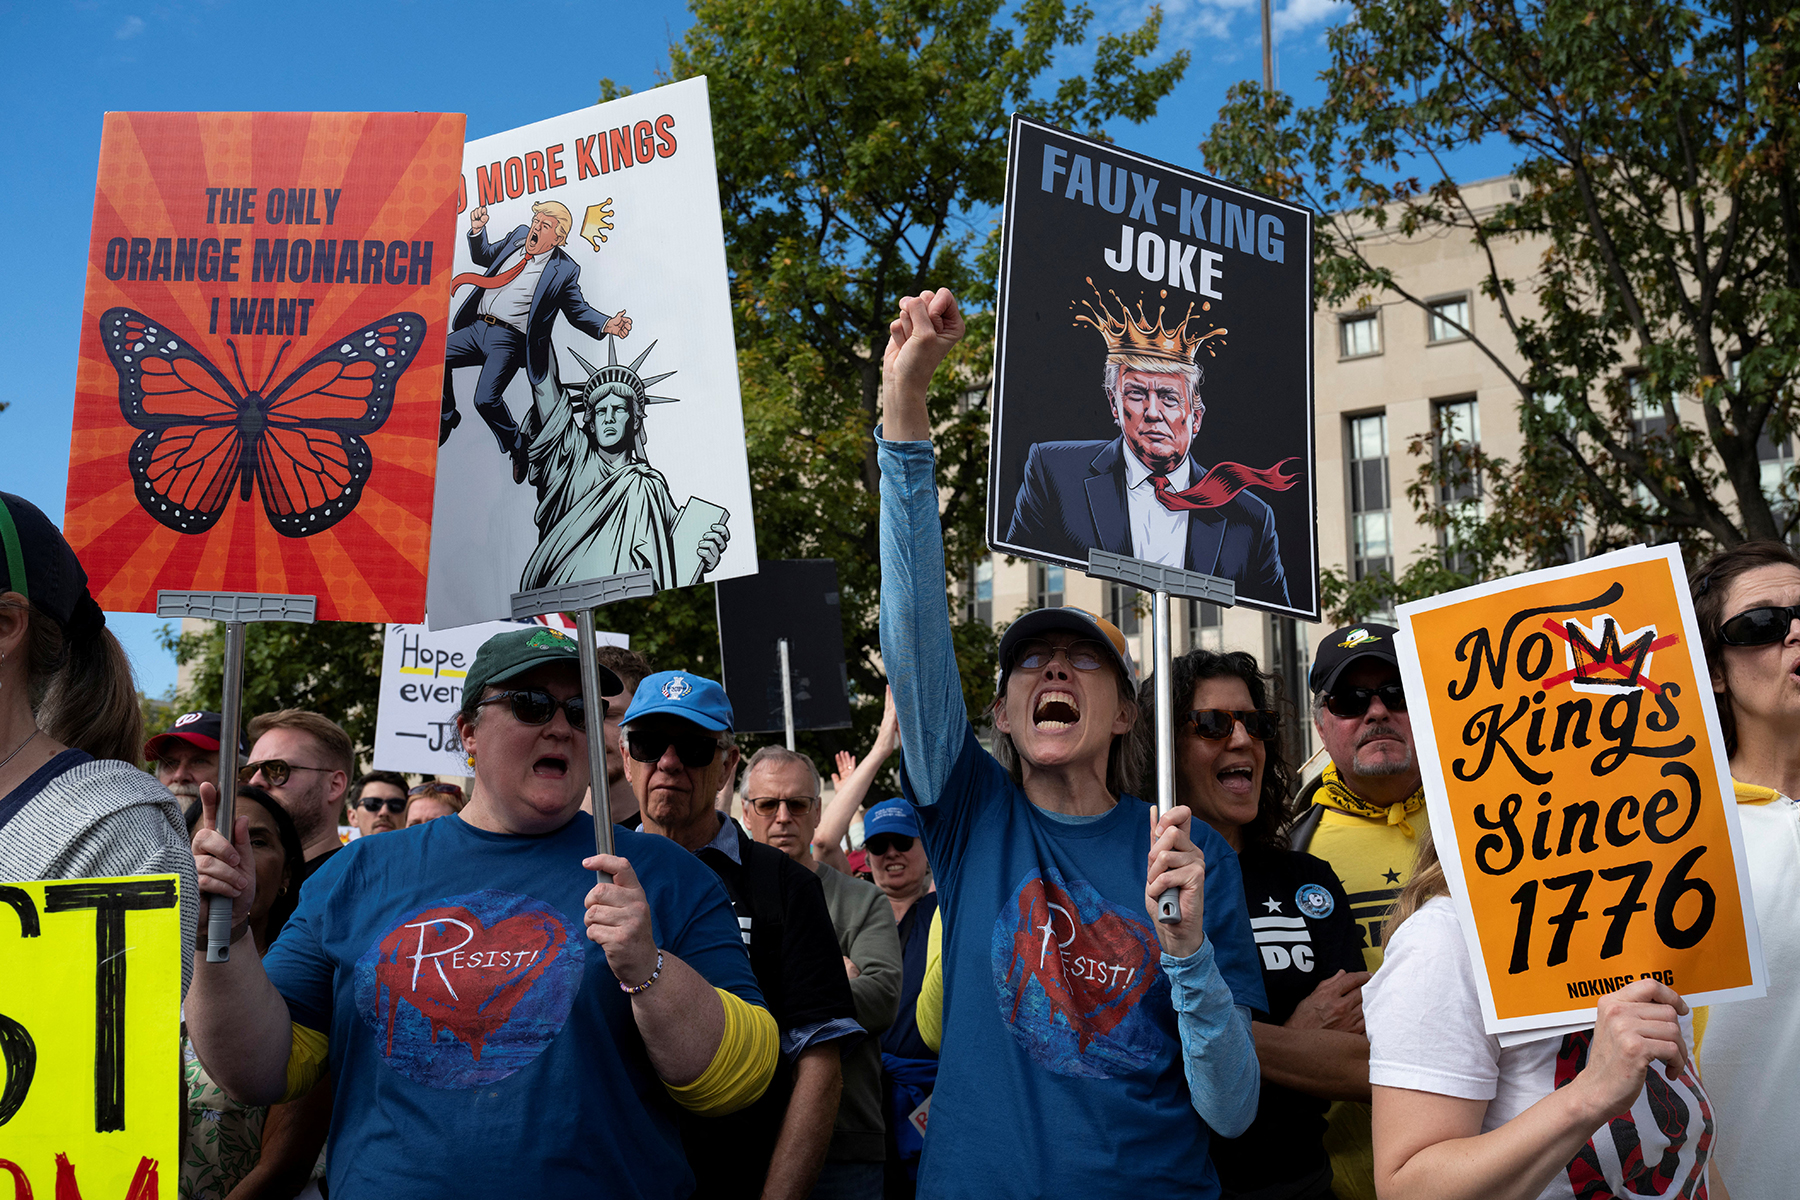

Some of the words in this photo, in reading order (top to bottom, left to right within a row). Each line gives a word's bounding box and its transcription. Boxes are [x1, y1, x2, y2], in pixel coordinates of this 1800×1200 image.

[476, 143, 567, 207] MORE
[575, 113, 678, 181] KINGS
[206, 187, 258, 225] THE
[265, 187, 342, 226] ONLY
[1040, 143, 1286, 265] FAUX-KING
[104, 236, 242, 283] ORANGE
[251, 238, 434, 286] MONARCH
[1104, 224, 1224, 301] JOKE
[208, 297, 220, 335] I
[229, 297, 315, 337] WANT
[1447, 581, 1624, 702] No
[400, 683, 464, 703] ever
[1452, 680, 1696, 786] Kings
[1473, 761, 1700, 876] Since
[1036, 901, 1135, 996] RESIST!
[1508, 845, 1717, 976] 1776
[403, 918, 539, 1001] RESIST!
[1259, 944, 1315, 973] DC
[1566, 969, 1675, 999] NOKINGSRG
